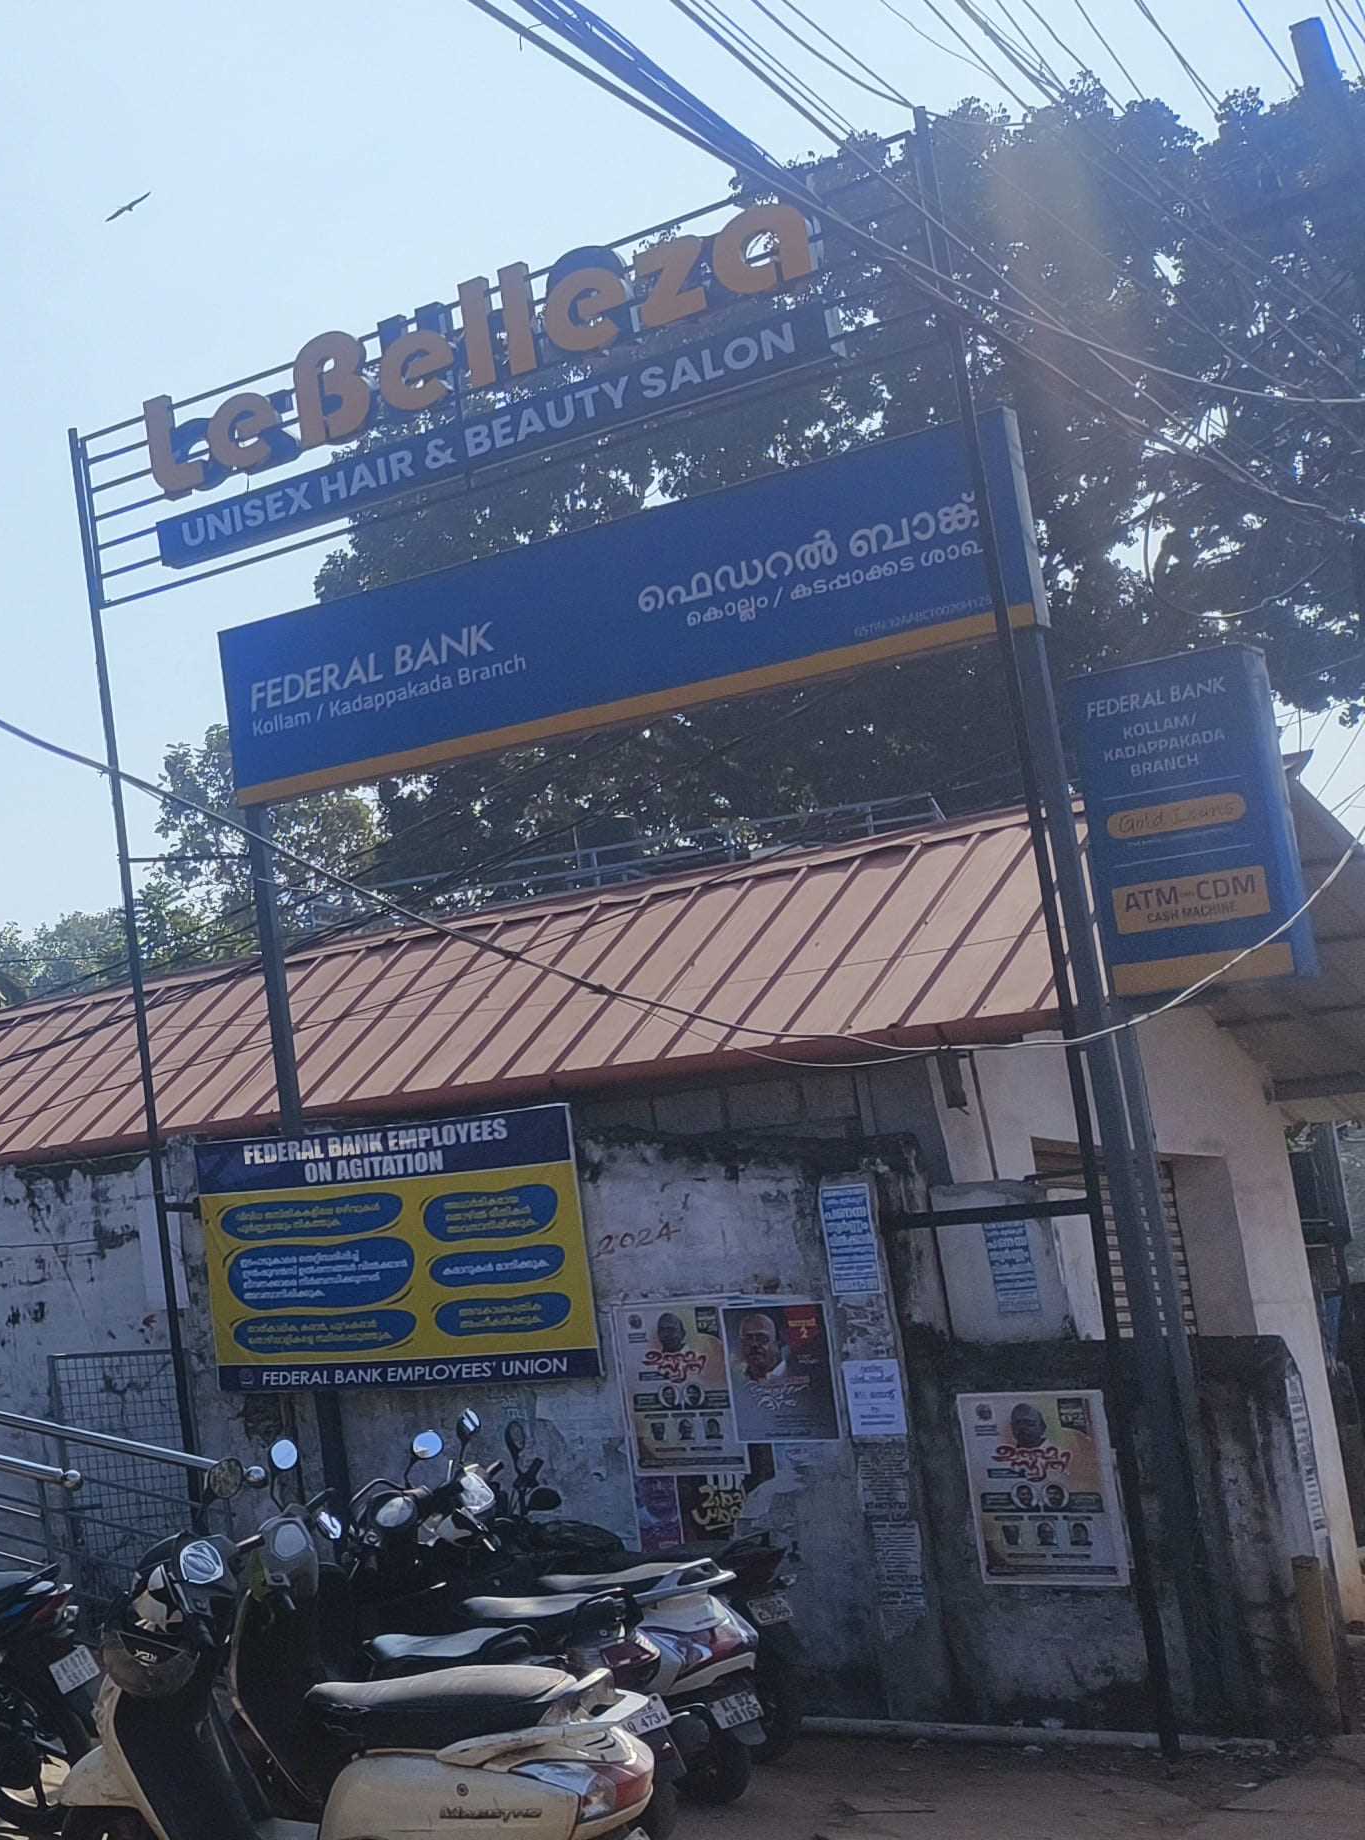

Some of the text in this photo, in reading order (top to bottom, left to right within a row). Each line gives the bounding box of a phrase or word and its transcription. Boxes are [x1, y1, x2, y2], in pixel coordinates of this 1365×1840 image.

[180, 322, 796, 548] UNISEX HAIR & BEAUTY SALON
[637, 529, 839, 613] ഫെഡറൽ
[250, 621, 494, 713] FEDERAL BANK
[252, 711, 311, 736] Kollam
[329, 673, 453, 718] Kadappakada
[458, 654, 526, 686] Branch
[1086, 676, 1226, 722] FEDERAL BANK
[1103, 727, 1225, 762] KADAPPAKADA
[1122, 712, 1197, 740] KOLLAM/
[1130, 753, 1200, 778] BRANCH
[1124, 874, 1256, 913] ATM CDM
[1146, 901, 1238, 924] CASH MACHINE
[243, 1118, 509, 1165] FEDERAL BANK EMPLOYEES
[304, 1149, 445, 1184] ON AGITATION
[261, 1357, 568, 1387] FEDERAL BANK EMPLOYEES' UNION
